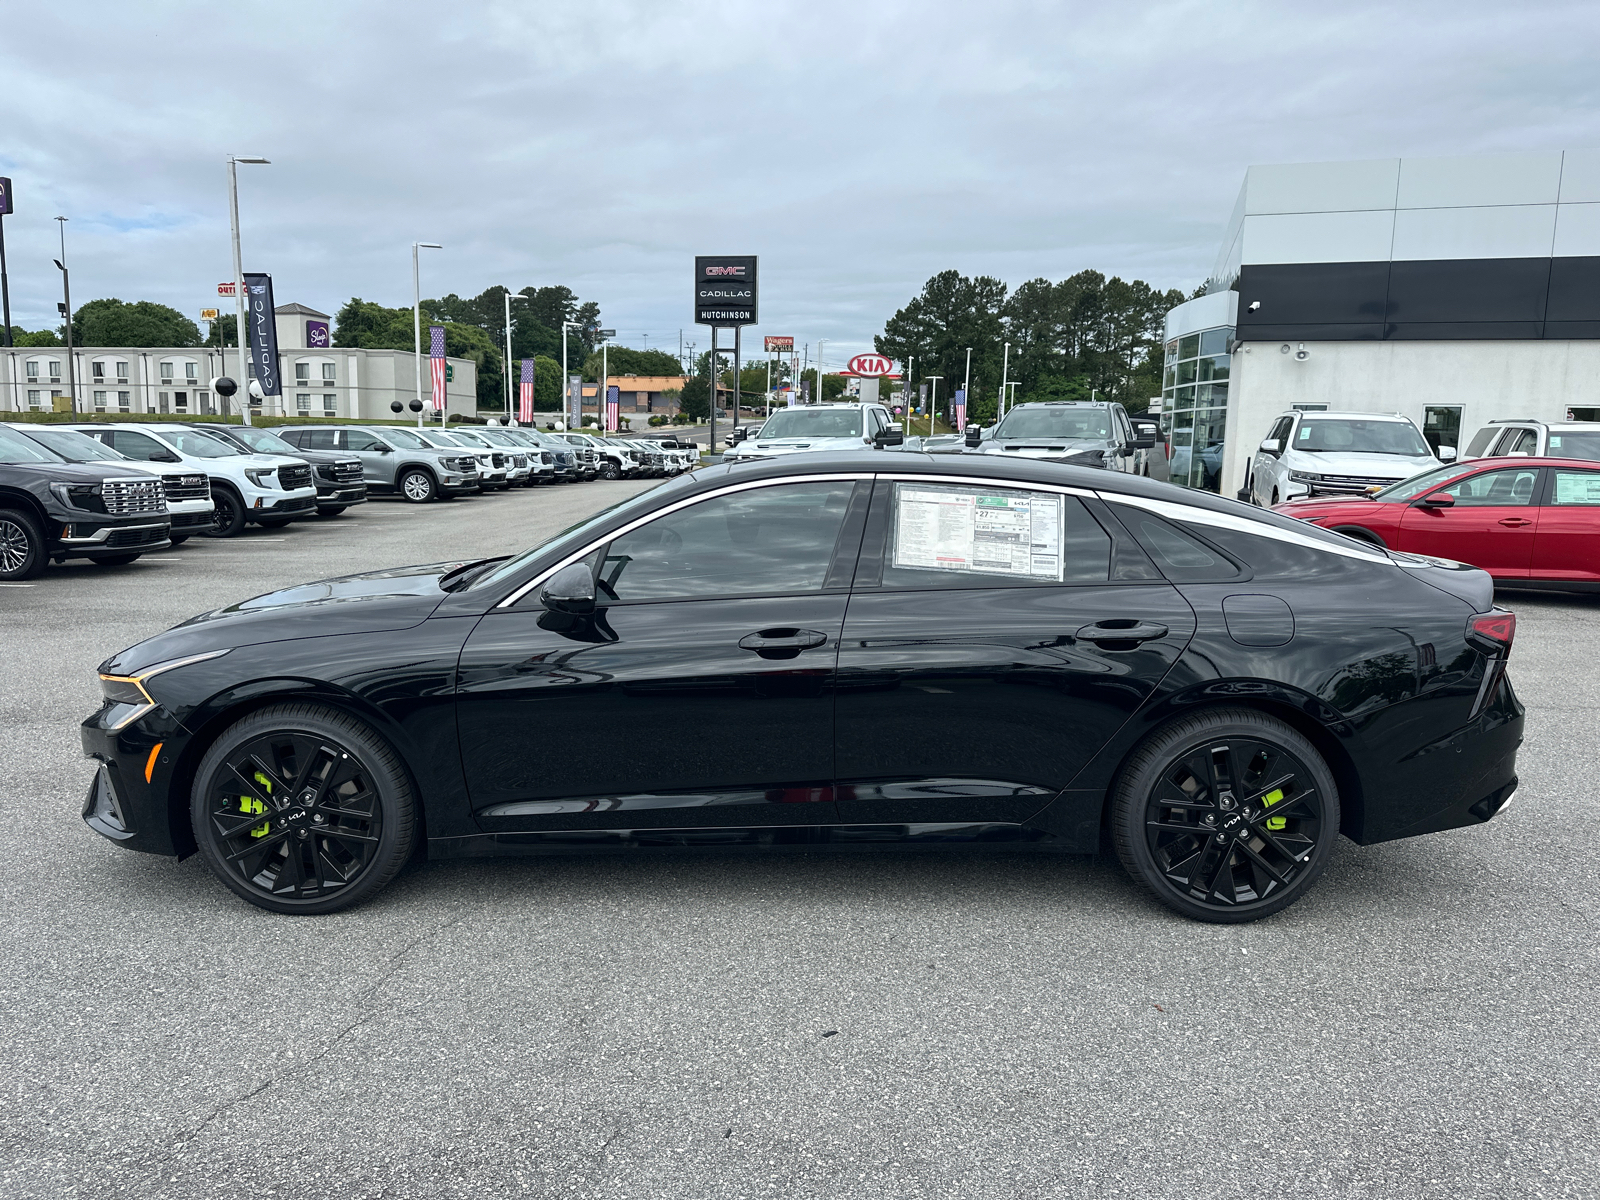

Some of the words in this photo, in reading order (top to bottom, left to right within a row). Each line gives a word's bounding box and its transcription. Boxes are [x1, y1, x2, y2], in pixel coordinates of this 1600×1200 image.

[706, 266, 745, 275] GMC
[856, 359, 885, 372] KIA
[980, 510, 988, 518] 27
